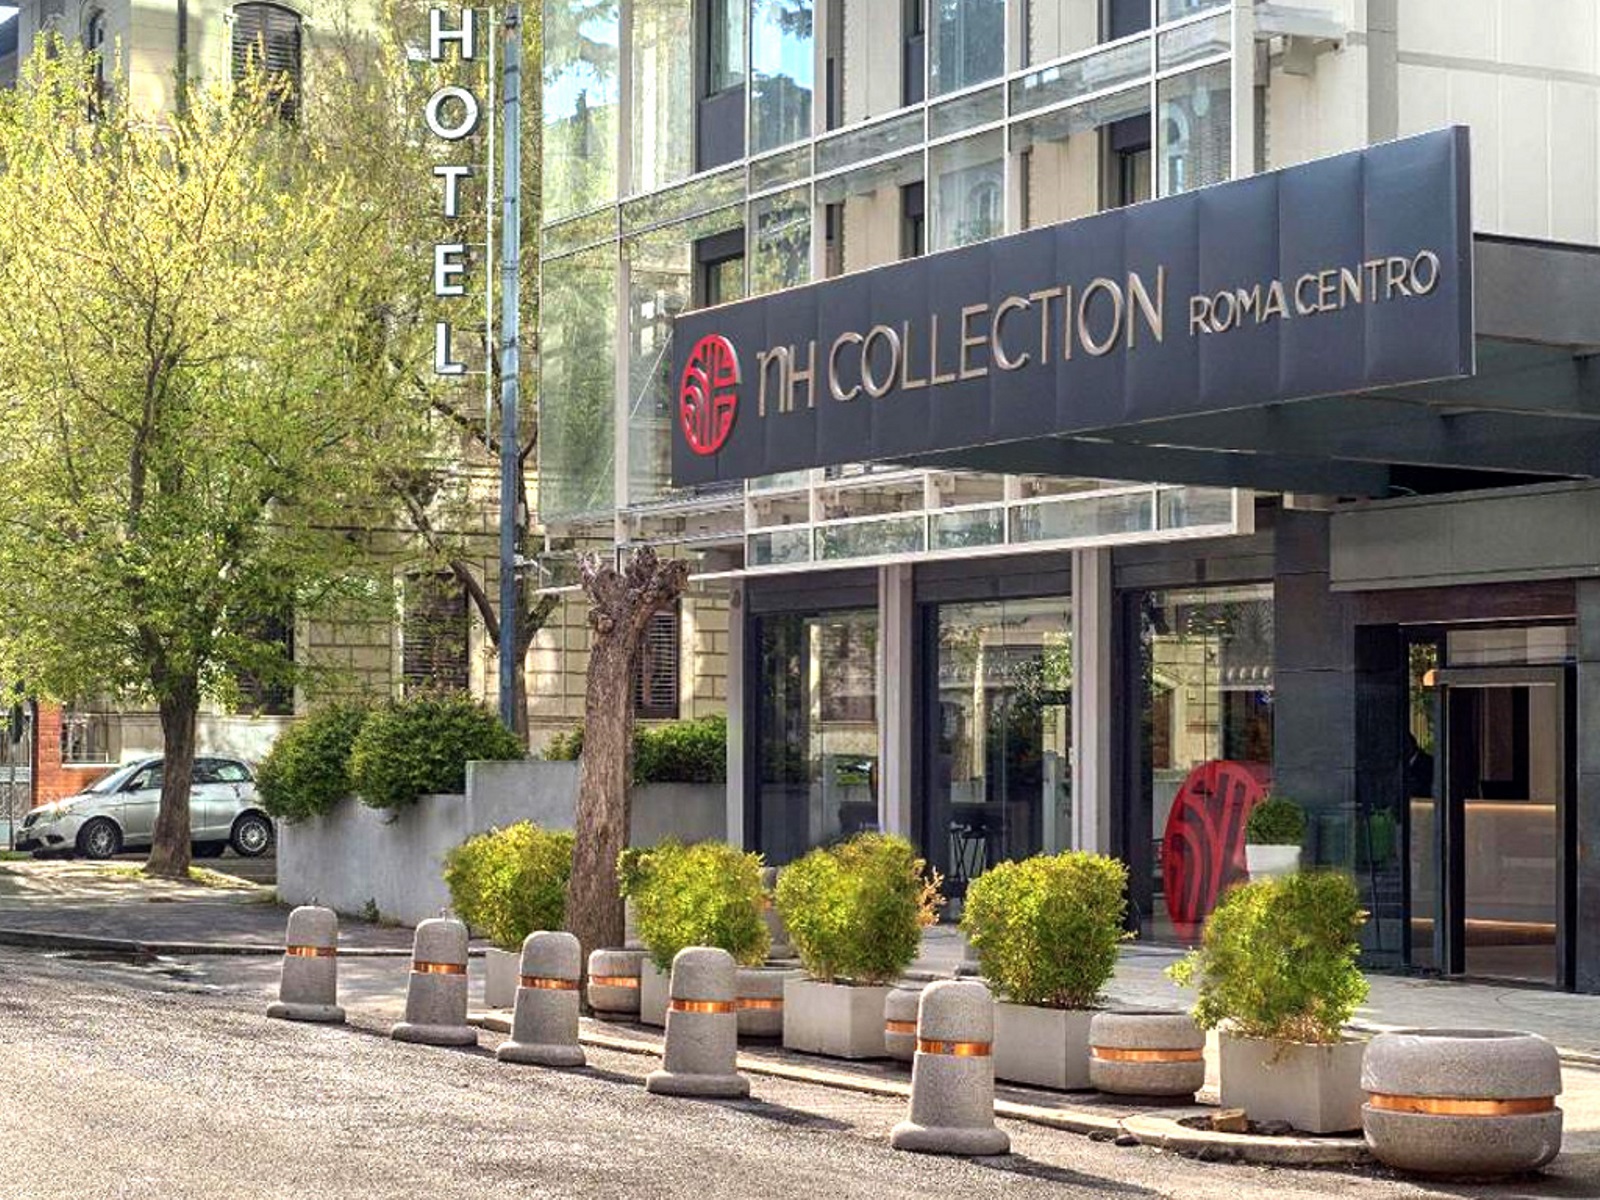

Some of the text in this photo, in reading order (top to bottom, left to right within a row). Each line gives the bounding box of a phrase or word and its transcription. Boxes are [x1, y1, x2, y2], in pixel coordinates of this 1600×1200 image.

[425, 8, 478, 375] HOTEL
[828, 264, 1167, 403] COLLECTION
[1189, 280, 1291, 337] ROMA
[1294, 249, 1441, 316] CENTRO
